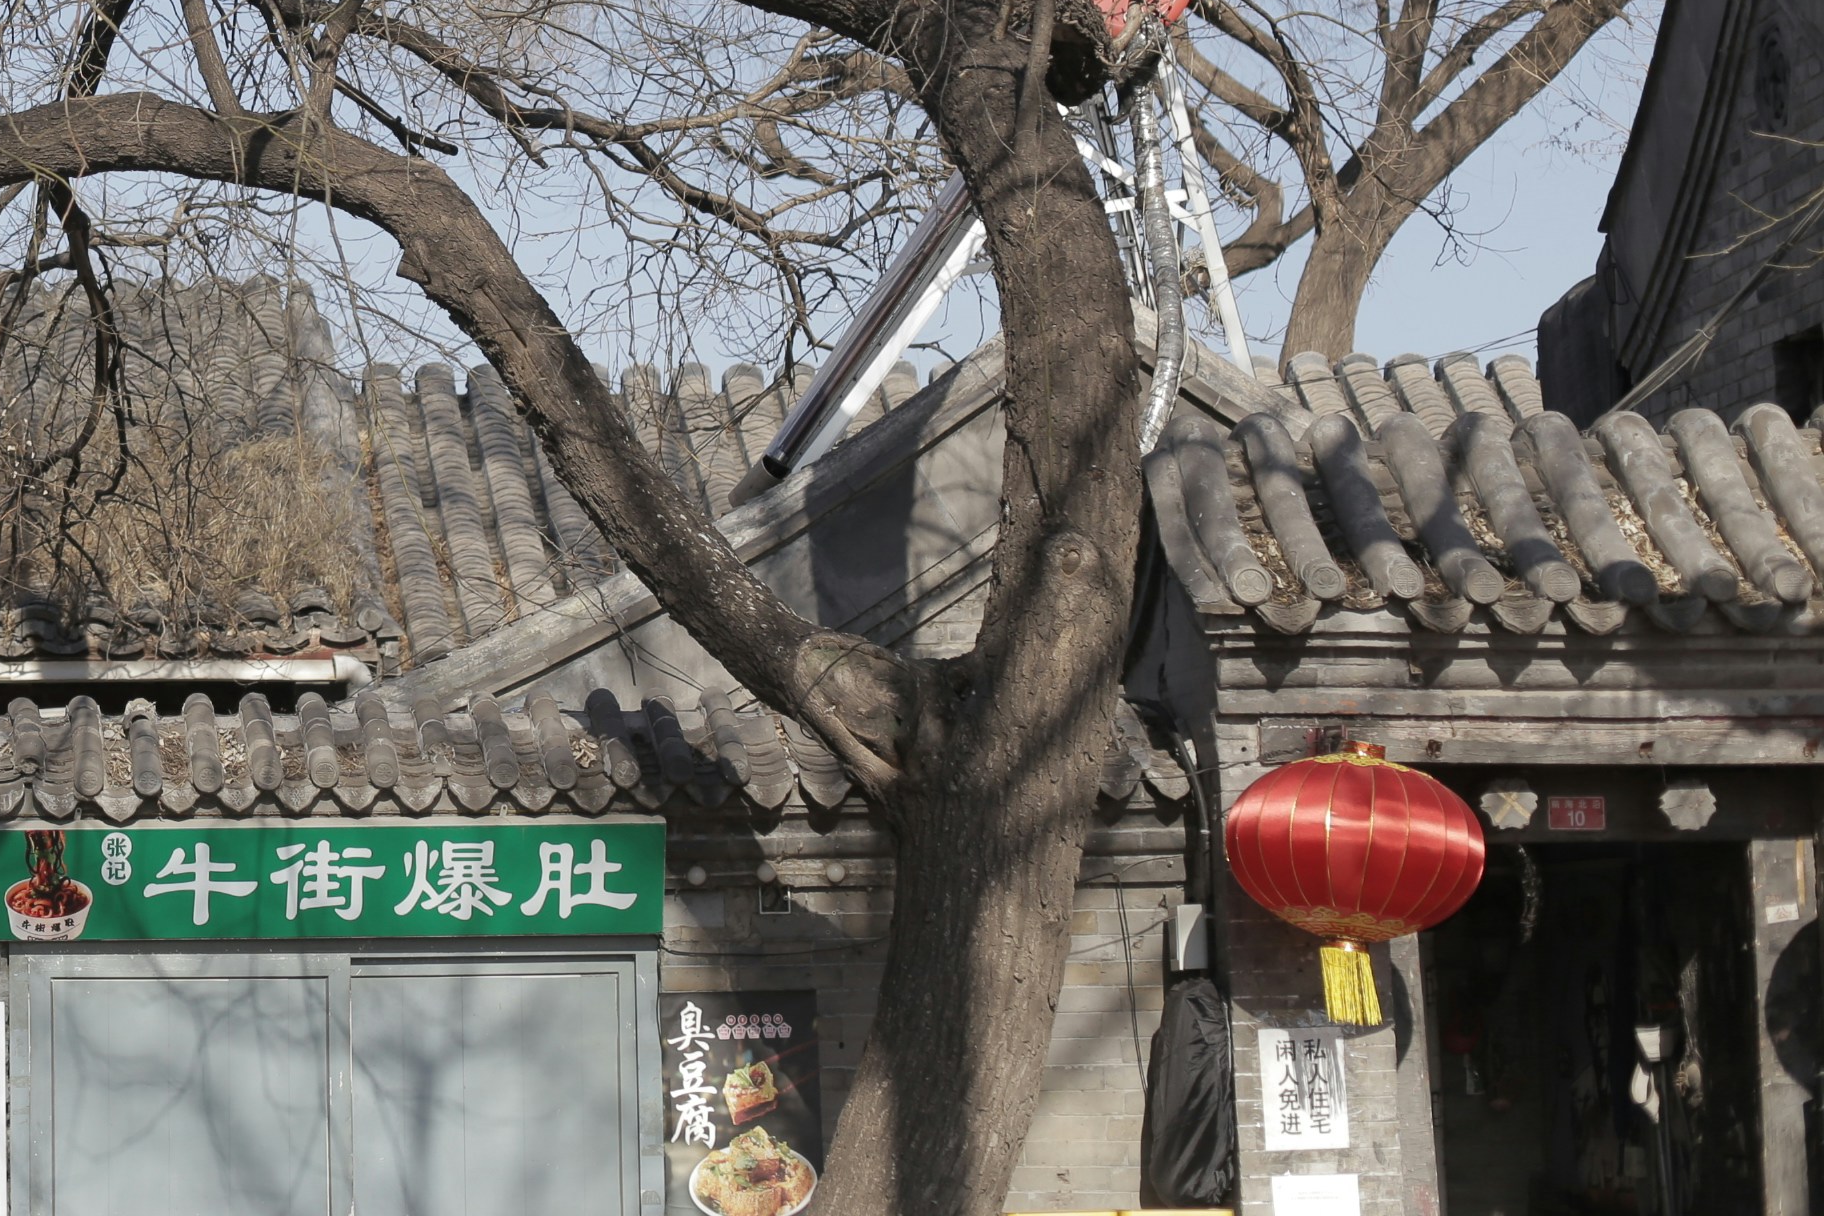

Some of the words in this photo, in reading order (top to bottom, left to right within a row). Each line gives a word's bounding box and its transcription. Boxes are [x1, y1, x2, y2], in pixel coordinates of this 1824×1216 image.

[106, 837, 127, 881] 张记
[1567, 810, 1586, 827] 10
[143, 838, 639, 926] 牛街爆肚
[667, 1000, 717, 1149] 臭豆腐
[1275, 1039, 1302, 1135] 闲人免进
[1303, 1038, 1332, 1134] 私人住宅
